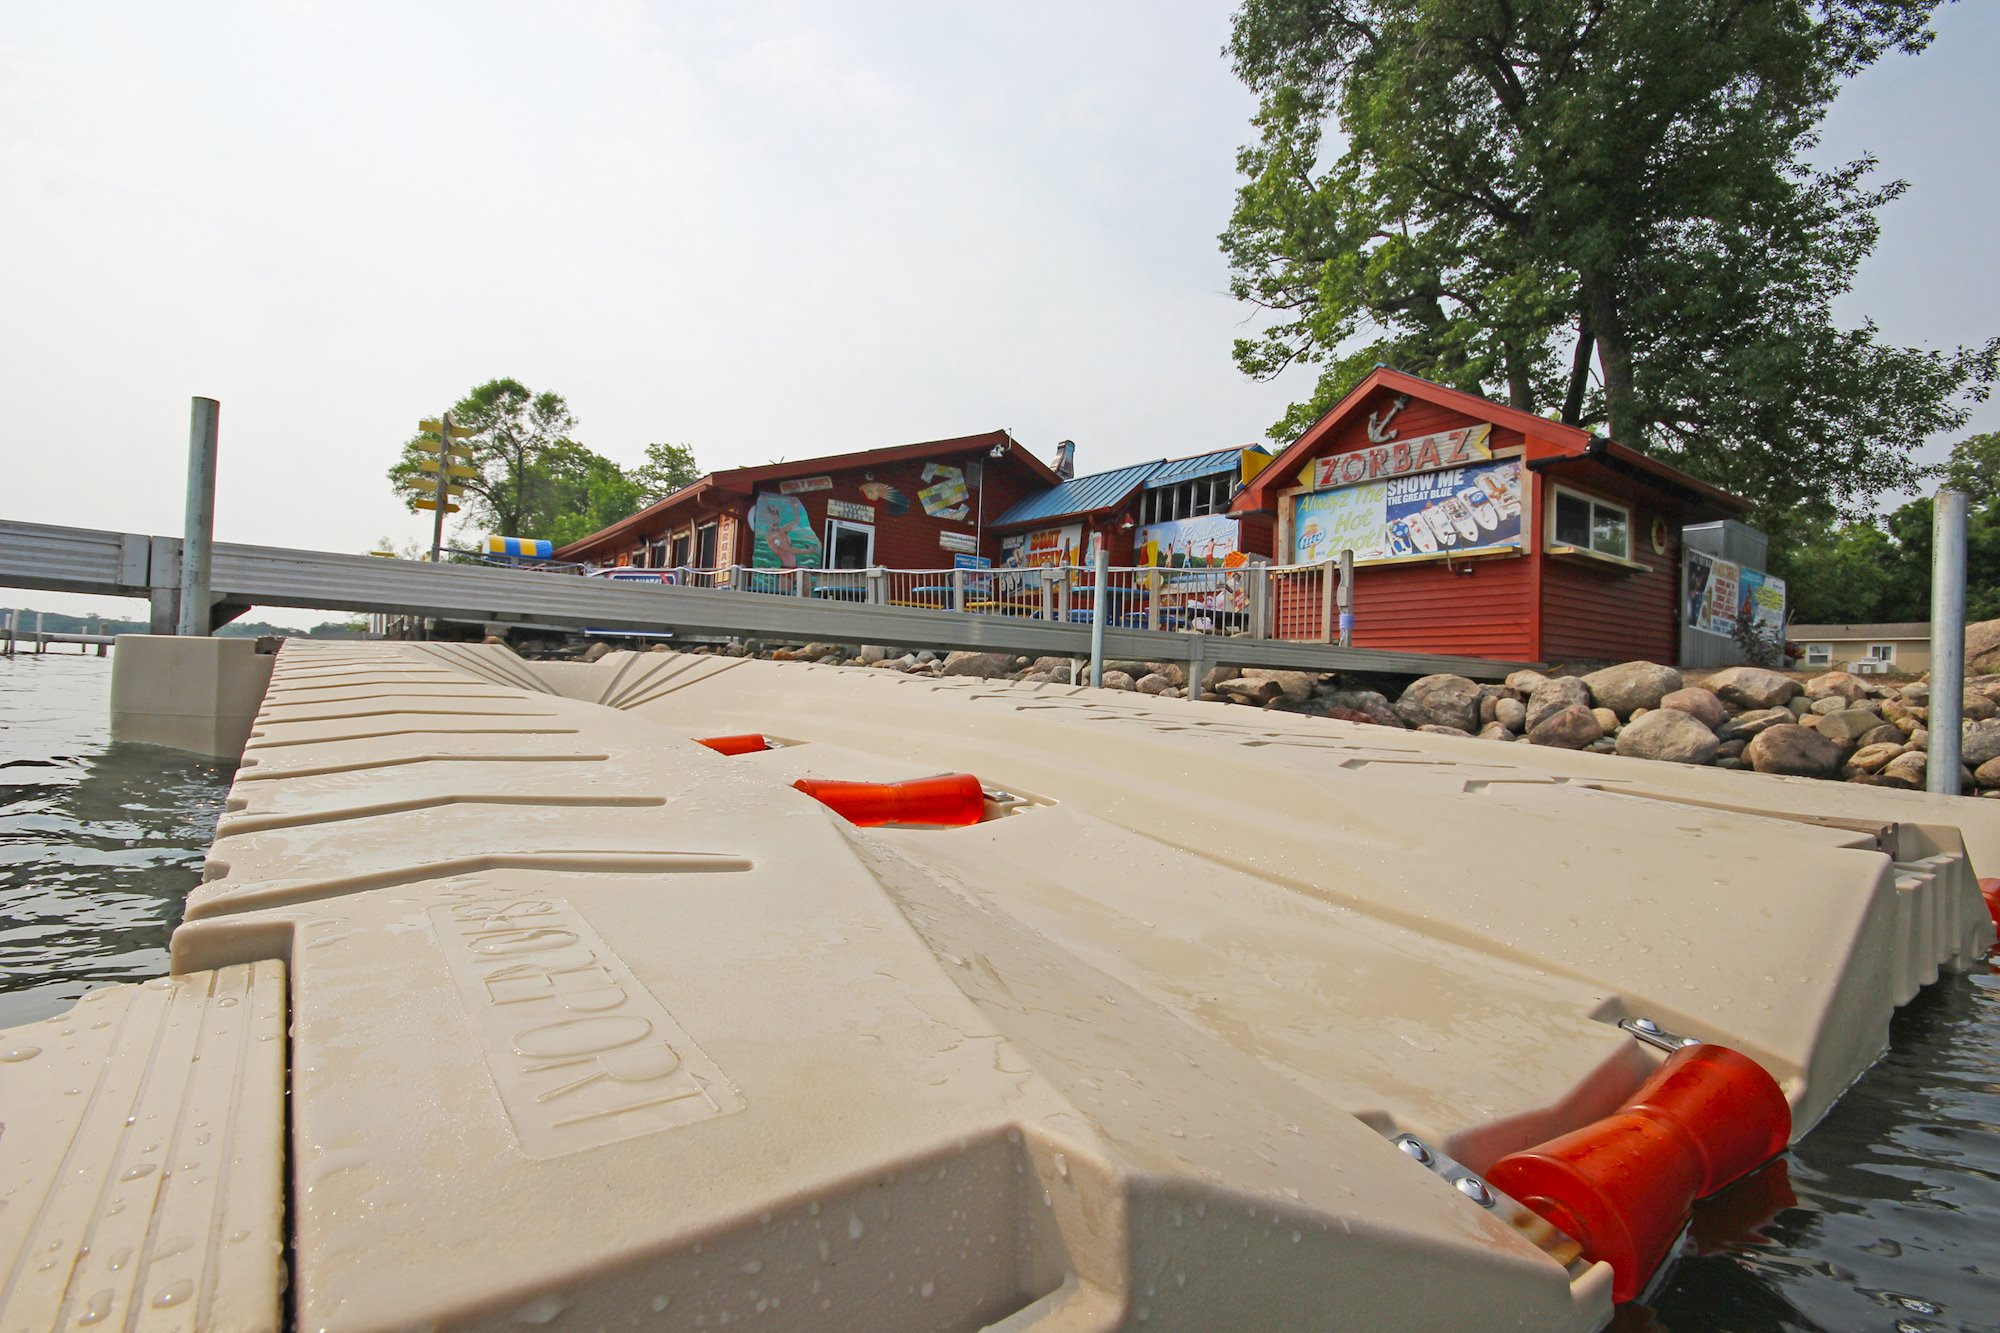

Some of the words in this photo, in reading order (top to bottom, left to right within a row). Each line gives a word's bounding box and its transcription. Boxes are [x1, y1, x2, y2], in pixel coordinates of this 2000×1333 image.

[1319, 428, 1472, 487] ZORBAZ
[1387, 474, 1437, 497] SHOW
[1438, 468, 1465, 488] ME
[1299, 493, 1350, 515] Alwayz
[1353, 486, 1385, 505] The
[1387, 494, 1403, 506] THE
[1403, 490, 1429, 504] GREAT
[1430, 487, 1452, 500] BLUE
[1335, 508, 1372, 534] Hot
[1030, 529, 1061, 551] BOAT
